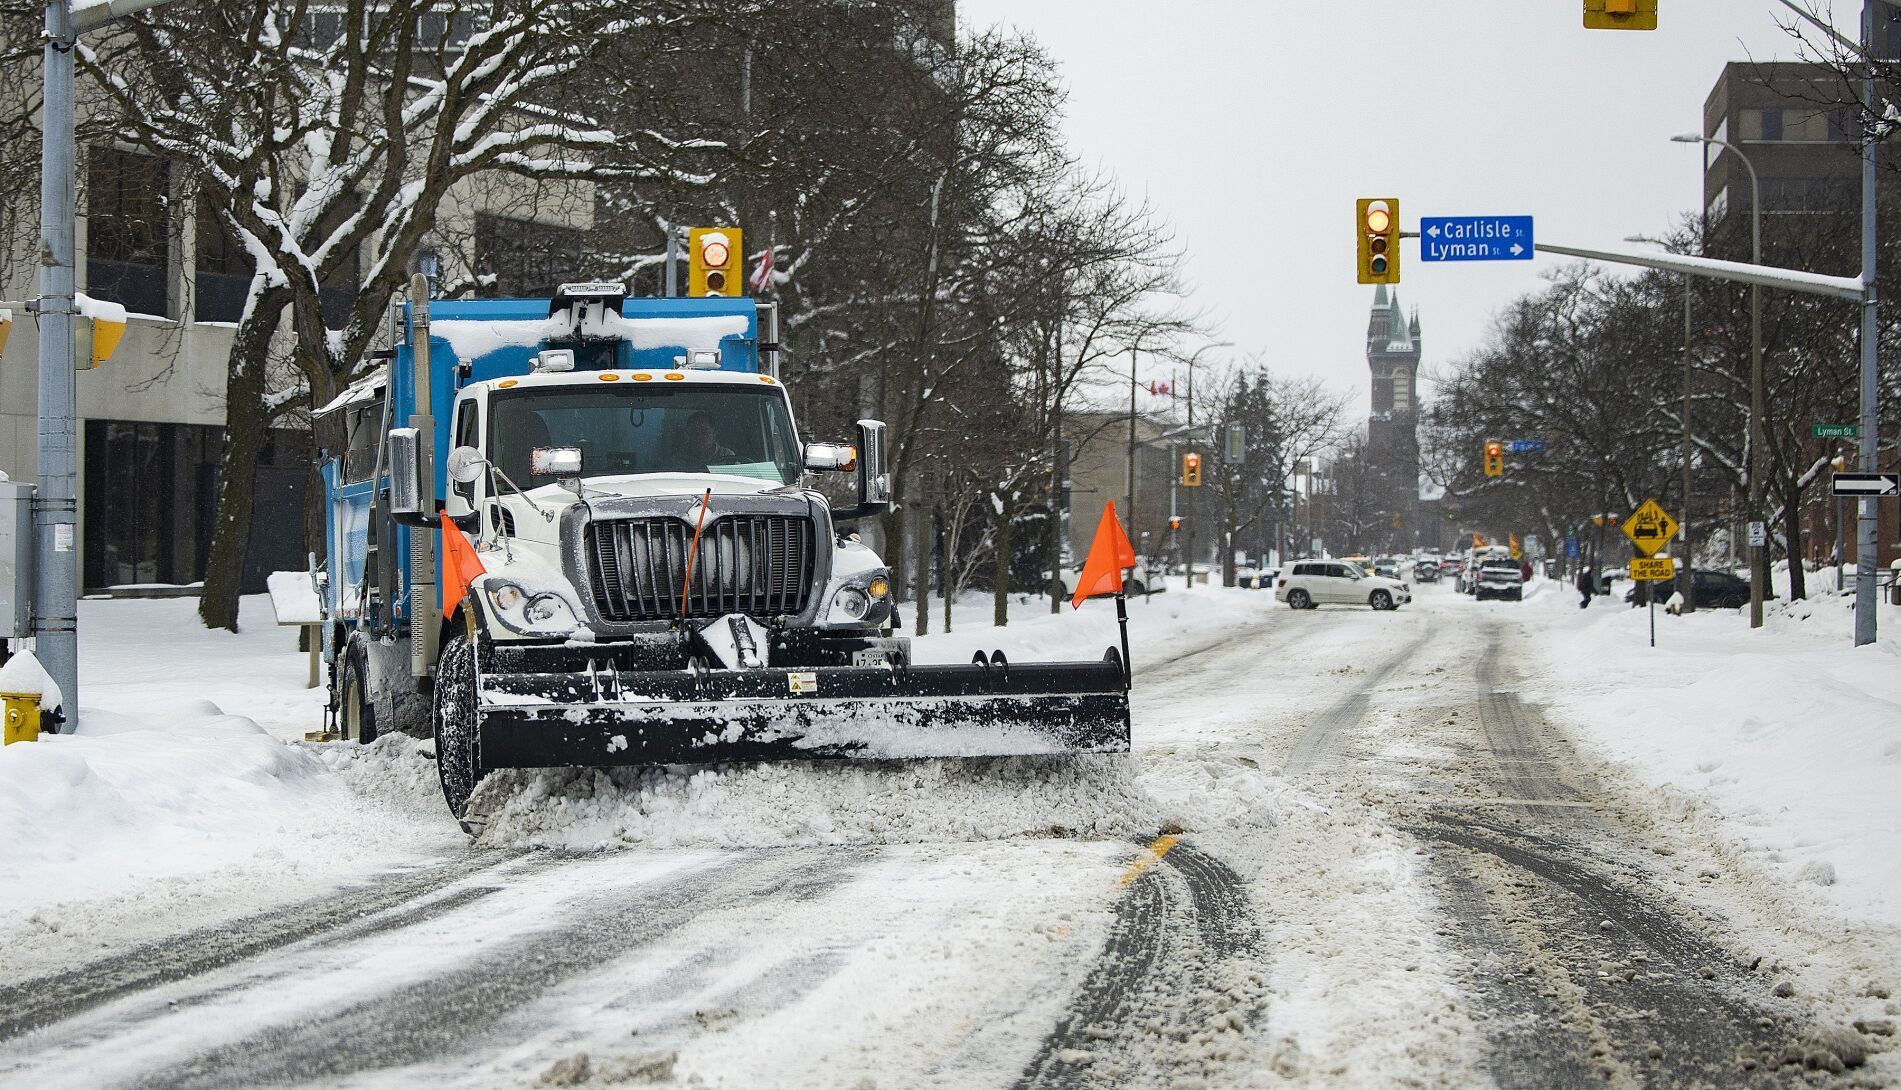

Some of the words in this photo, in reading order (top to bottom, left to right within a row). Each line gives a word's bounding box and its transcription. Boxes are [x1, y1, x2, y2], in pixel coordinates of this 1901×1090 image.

[1444, 220, 1511, 238] Carlisle
[1430, 241, 1489, 260] Lyman
[1817, 427, 1842, 437] Lyman
[1843, 428, 1854, 436] St.
[1639, 561, 1664, 569] SHARE
[1633, 569, 1647, 577] THE
[1650, 569, 1671, 577] ROAD
